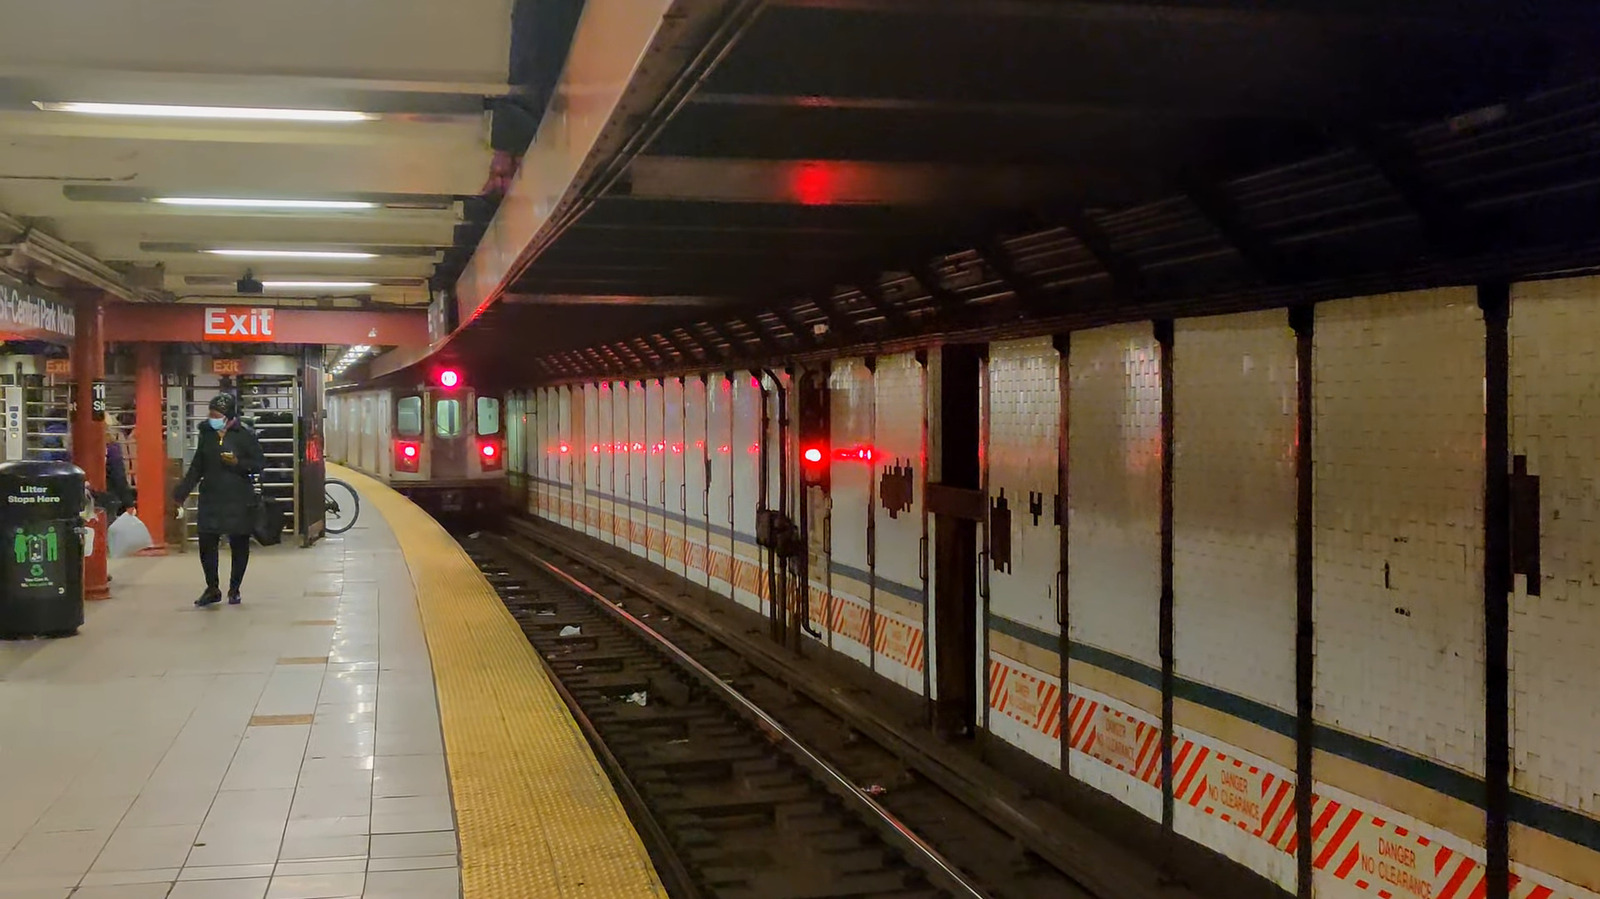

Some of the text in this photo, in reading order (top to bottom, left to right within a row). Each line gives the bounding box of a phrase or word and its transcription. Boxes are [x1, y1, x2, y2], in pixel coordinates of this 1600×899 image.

[40, 298, 57, 332] Park
[205, 307, 273, 336] Exit
[213, 360, 239, 372] Exit
[8, 495, 60, 504] Stops Here
[1221, 769, 1248, 796] DANGER
[1208, 783, 1260, 821] NO CLEARANCE
[1378, 836, 1416, 869] DANGER
[1361, 853, 1433, 899] NO CLEARANCE
